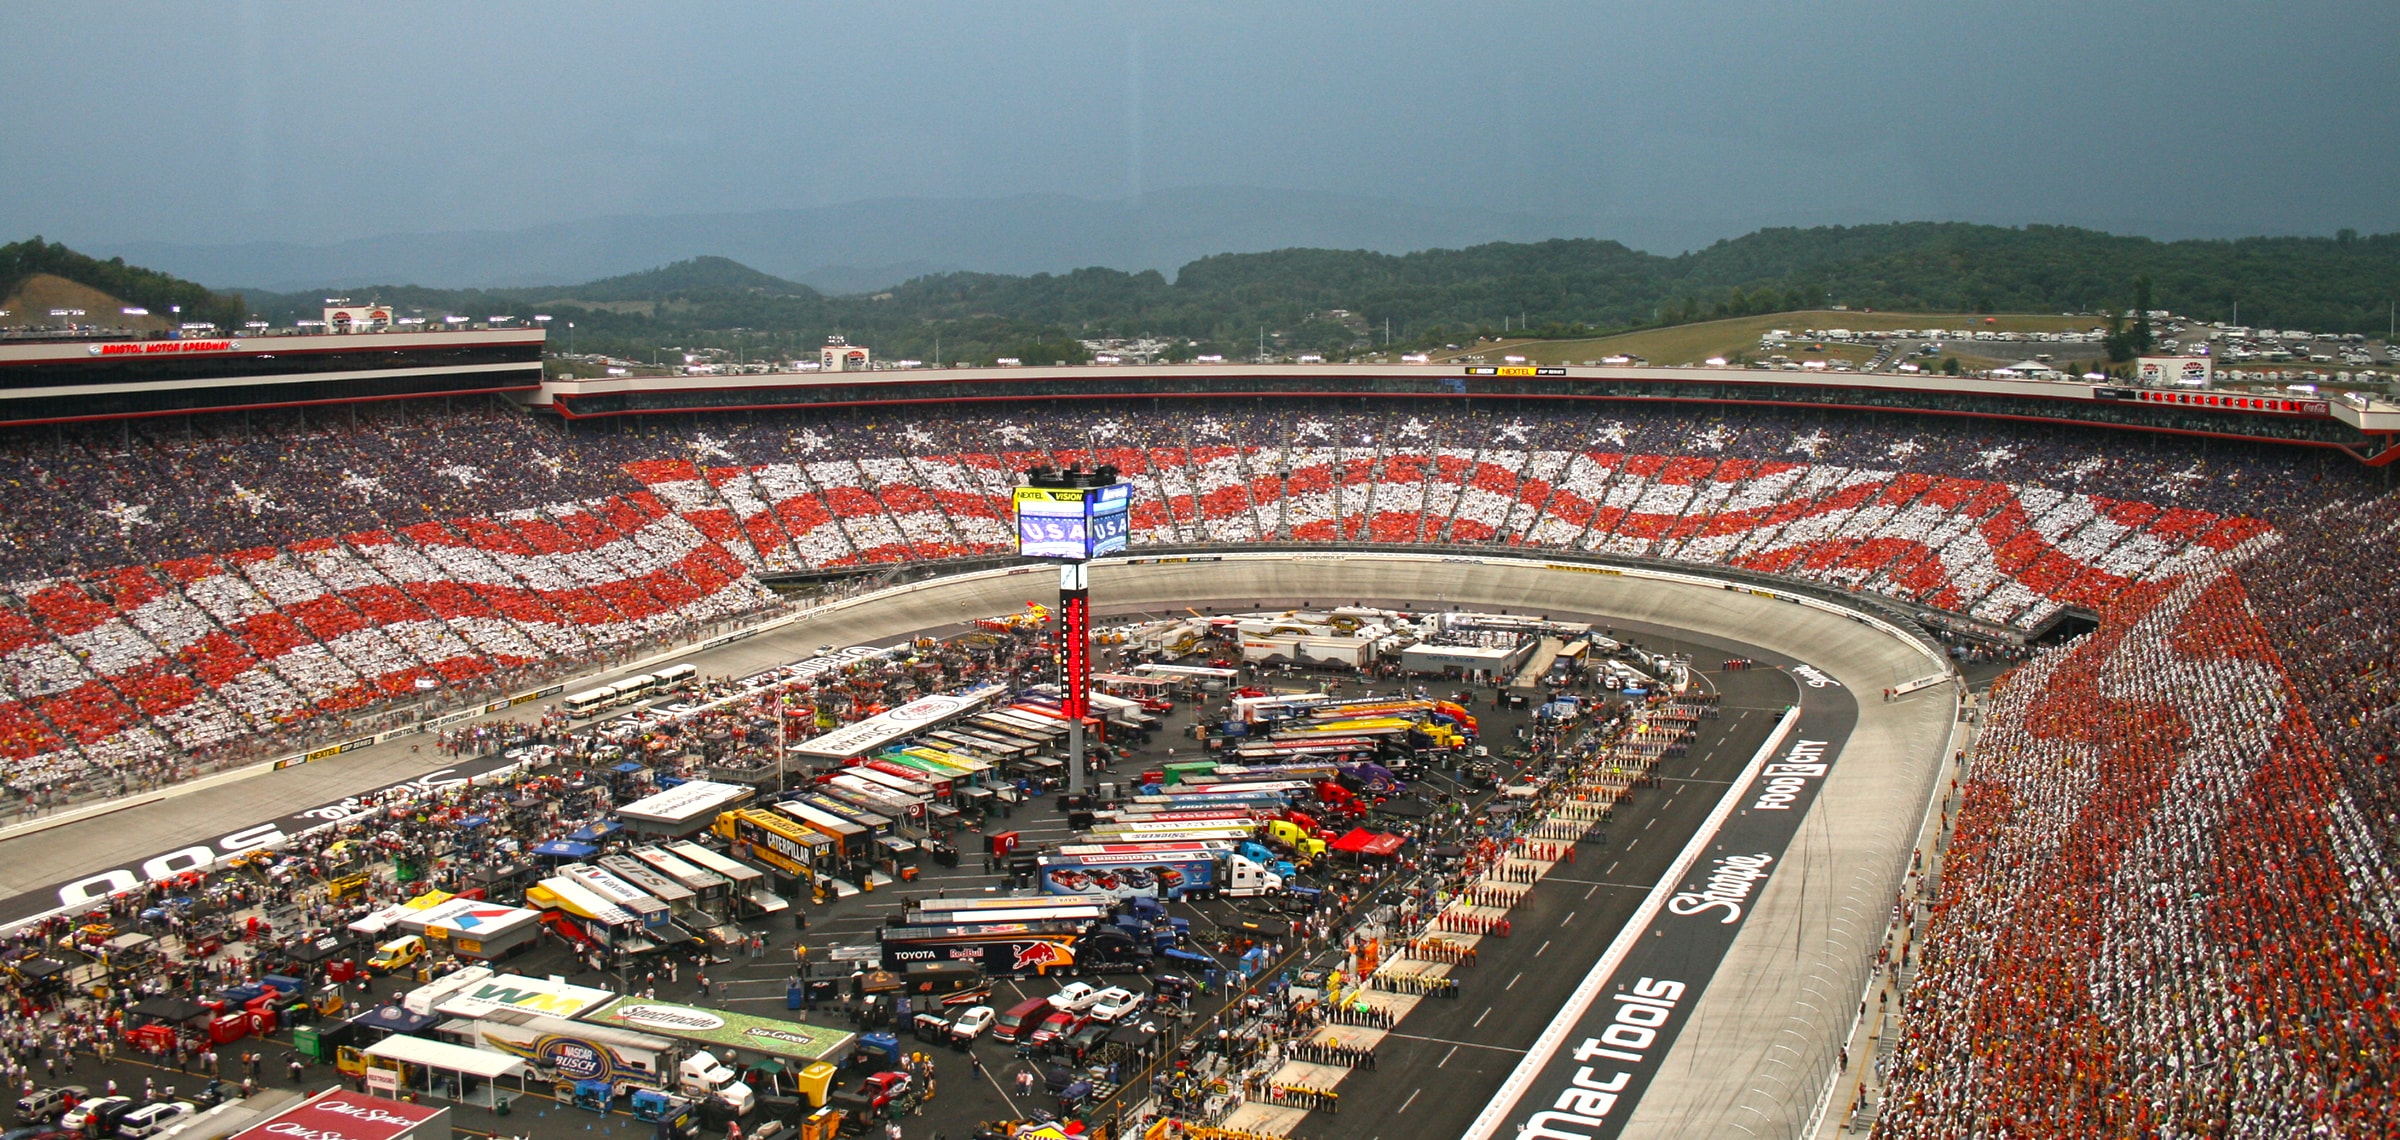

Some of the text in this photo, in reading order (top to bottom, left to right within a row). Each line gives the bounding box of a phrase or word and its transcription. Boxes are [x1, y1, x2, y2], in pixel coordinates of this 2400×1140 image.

[102, 341, 231, 355] BRISTOL MOTOR SPEEDWAY
[1501, 367, 1531, 376] NEXTEL
[1017, 491, 1083, 501] NEXTEL VISION
[440, 711, 472, 725] SPEEDWAY
[309, 748, 338, 761] NEXTEL
[341, 743, 353, 752] CUP
[1753, 776, 1806, 810] FOOD
[1785, 739, 1828, 763] CITY
[1131, 832, 1189, 840] SNICKERS
[767, 830, 810, 865] CATERPILLAR
[815, 843, 831, 856] CAT
[59, 822, 287, 906] 500
[1086, 854, 1154, 862] Motorcraft
[615, 858, 668, 887] UPS
[1668, 852, 1773, 924] Sharpie
[316, 936, 336, 946] Office
[895, 950, 936, 960] TOYOTA
[472, 983, 586, 1015] WM
[499, 1002, 567, 1019] MANAGEMENT
[624, 1005, 718, 1029] Spectracide
[1573, 976, 1687, 1063] Tools
[746, 1027, 810, 1045] Sta-Green
[564, 1045, 594, 1061] NASCAR
[555, 1055, 598, 1072] BUSCH
[368, 1073, 396, 1085] RESTROOMS
[315, 1100, 418, 1127] Old Spice
